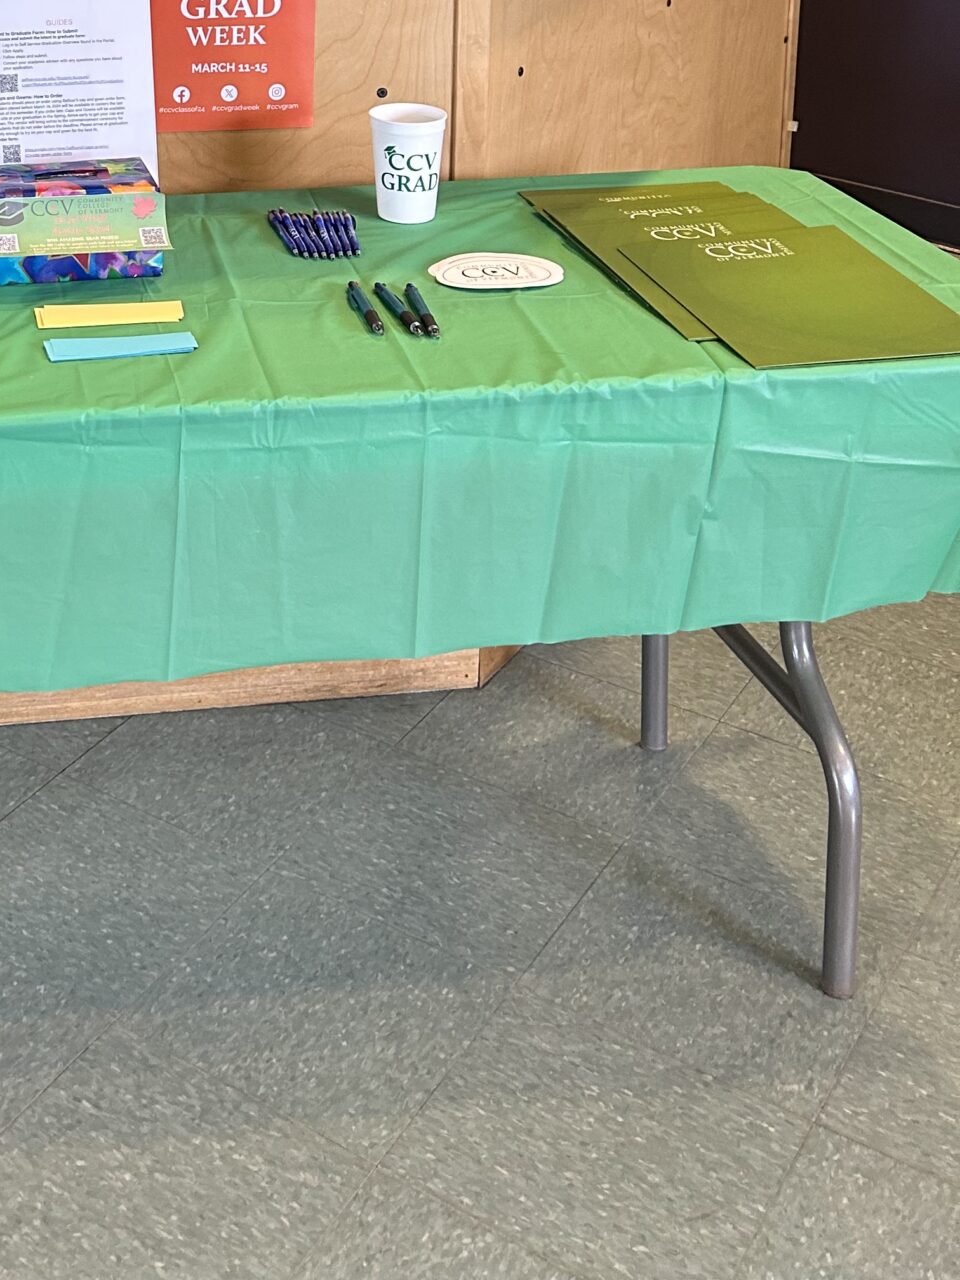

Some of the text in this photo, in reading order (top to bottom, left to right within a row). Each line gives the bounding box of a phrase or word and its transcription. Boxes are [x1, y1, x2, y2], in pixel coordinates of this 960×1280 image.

[185, 25, 266, 47] WEEK
[192, 63, 268, 73] MARCH 11-15
[388, 152, 437, 171] CCV
[381, 172, 438, 192] GRAD
[31, 199, 74, 217] CCV
[650, 225, 716, 240] CCV
[705, 241, 773, 258] CCV
[462, 266, 520, 279] CCV
